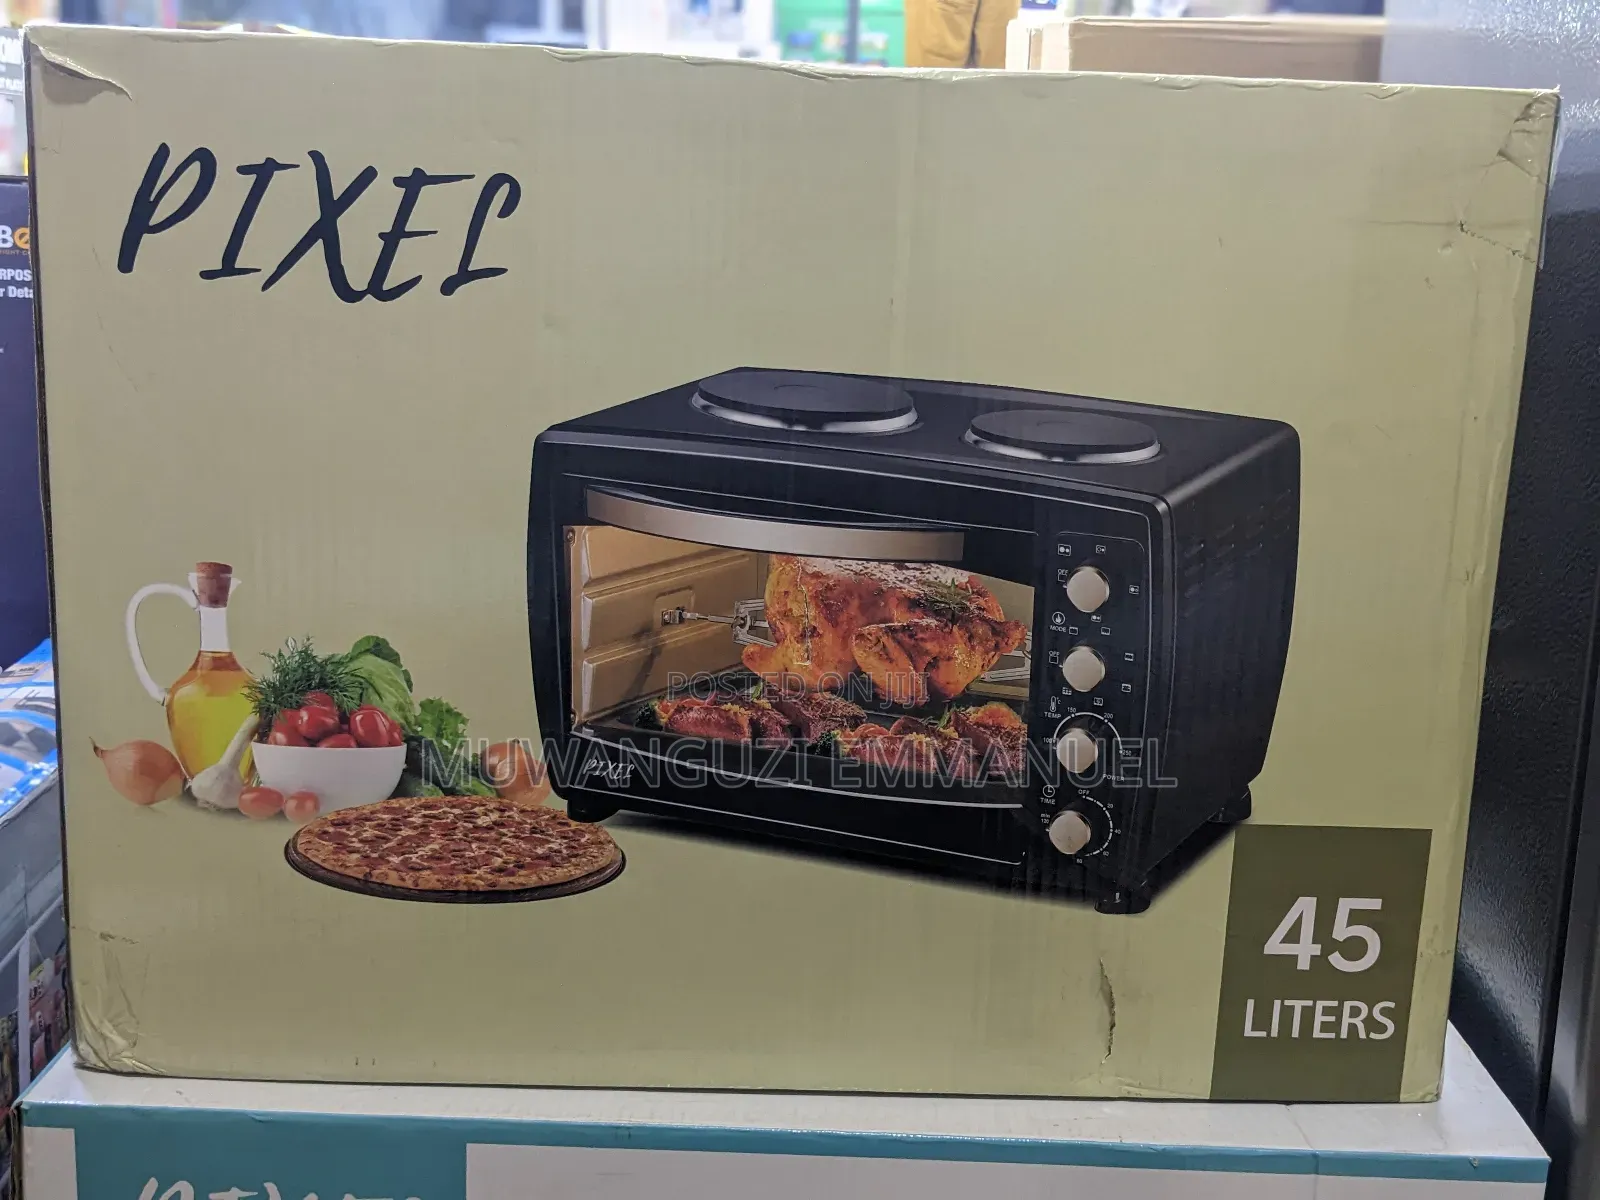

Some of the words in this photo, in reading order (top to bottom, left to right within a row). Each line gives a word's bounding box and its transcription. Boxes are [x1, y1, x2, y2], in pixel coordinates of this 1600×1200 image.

[117, 142, 522, 304] PIXEL
[1049, 625, 1067, 633] MODE
[582, 758, 635, 780] PIXEL
[1102, 773, 1125, 782] POWER
[1040, 797, 1056, 805] TIME
[1263, 896, 1383, 973] 45
[1243, 998, 1396, 1040] LITERS
